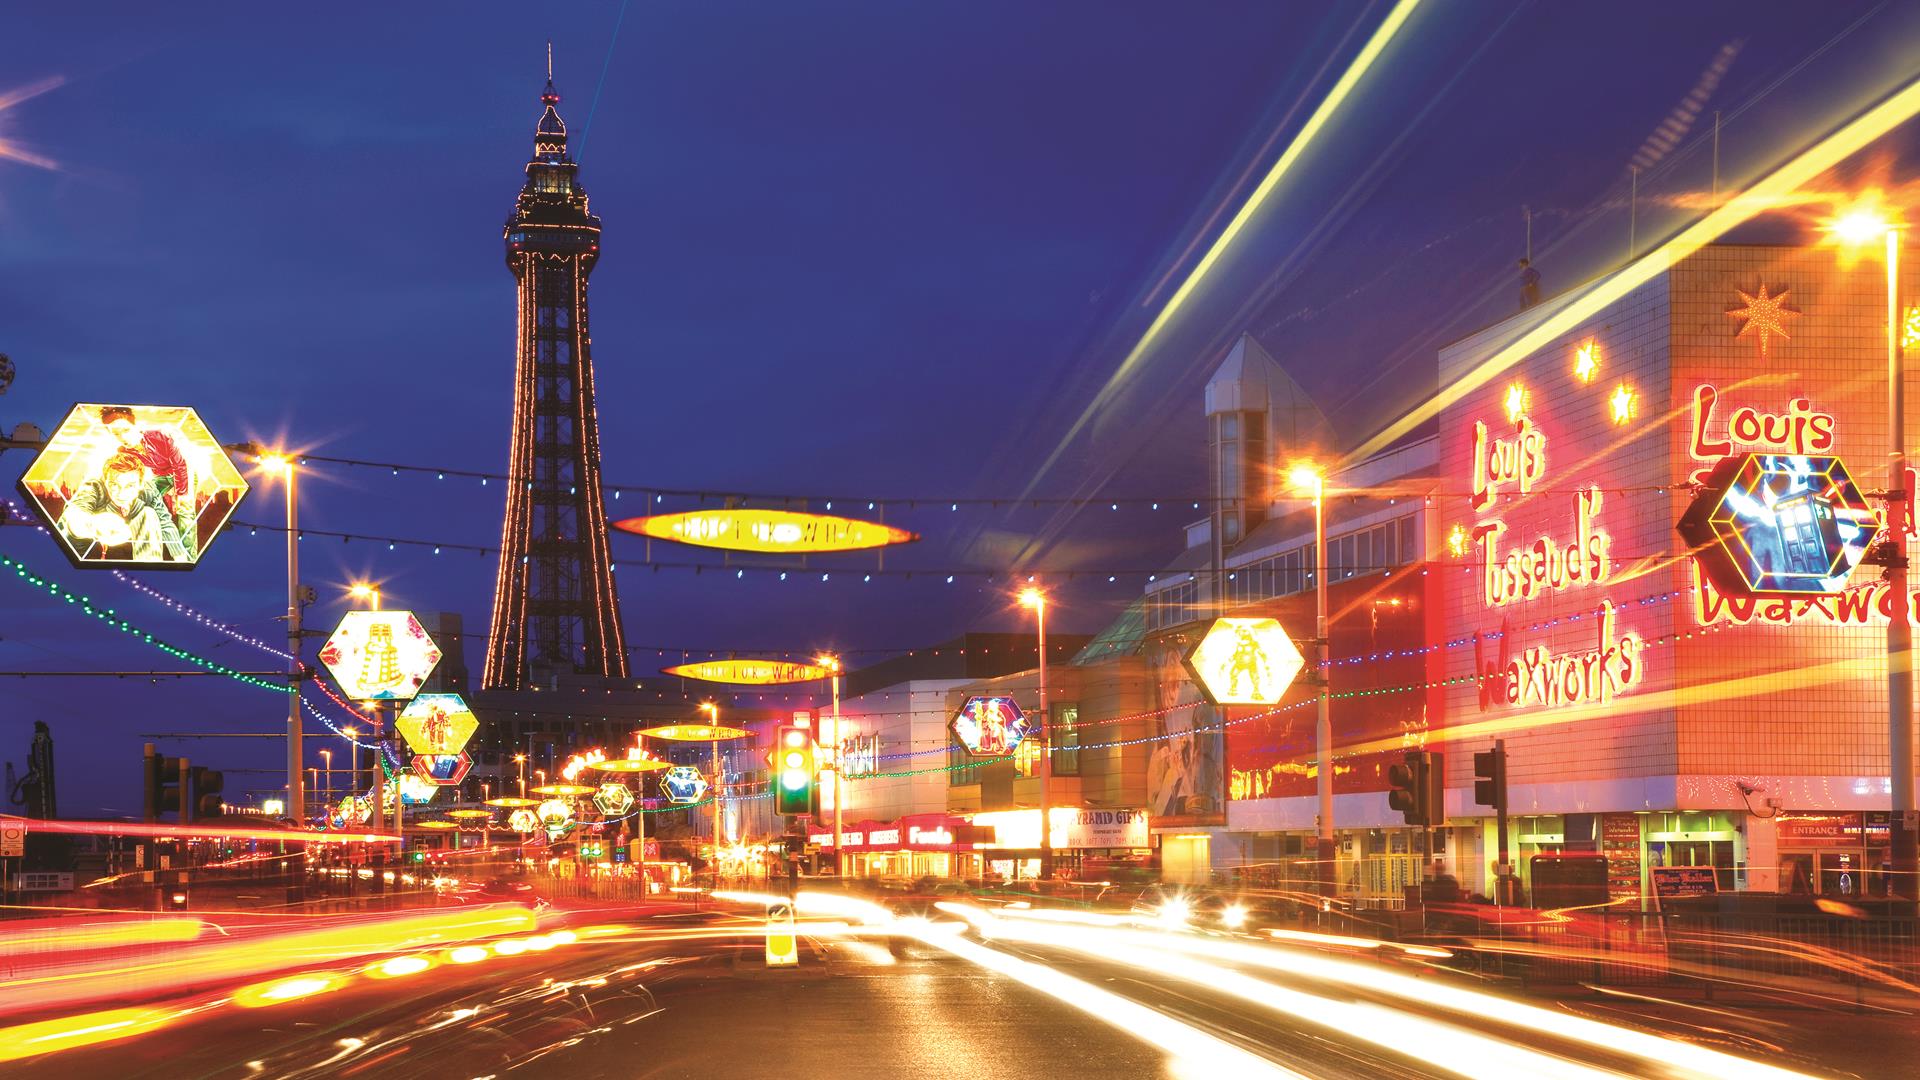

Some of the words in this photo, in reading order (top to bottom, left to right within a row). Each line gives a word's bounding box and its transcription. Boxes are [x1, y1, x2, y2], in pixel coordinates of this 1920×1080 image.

[1690, 384, 1834, 460] Louis
[1472, 418, 1546, 512] Louis
[1472, 486, 1611, 607] Tussaud's
[773, 665, 806, 680] WHO
[1474, 600, 1643, 713] Waxworks
[1071, 812, 1113, 825] YRAMID
[1792, 826, 1838, 834] ENTRANCE
